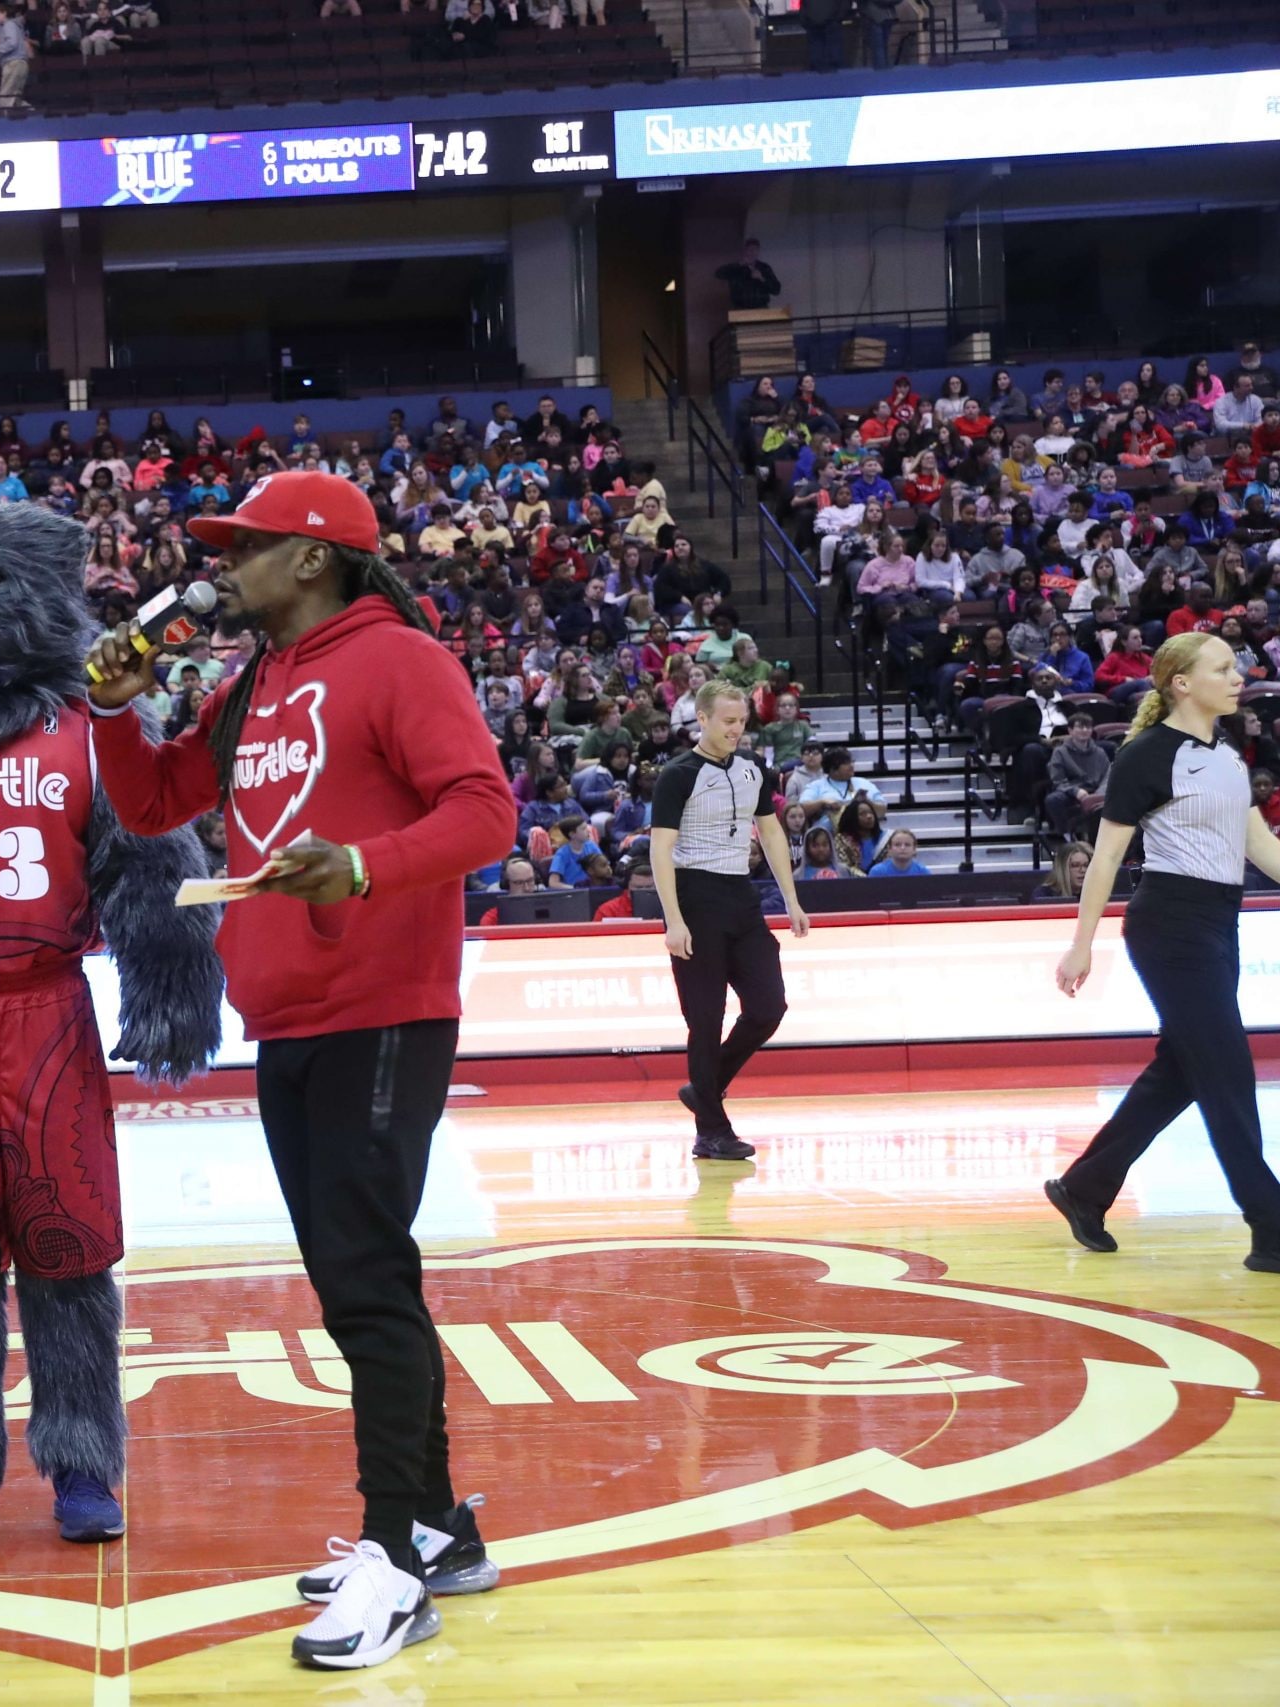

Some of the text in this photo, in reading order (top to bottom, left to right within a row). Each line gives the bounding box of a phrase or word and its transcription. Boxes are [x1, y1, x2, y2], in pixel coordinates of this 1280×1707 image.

[262, 135, 402, 164] 6 TIMEOUTS
[542, 121, 584, 154] 1ST
[671, 121, 812, 150] RENASANT
[414, 131, 488, 178] 7:42
[532, 155, 609, 173] QUARTER
[762, 146, 812, 163] BANK
[0, 159, 16, 199] 2
[117, 150, 194, 190] BLUE
[263, 161, 359, 186] 0 FOULS
[235, 741, 267, 758] mphis
[524, 976, 640, 1009] OFFICIAL
